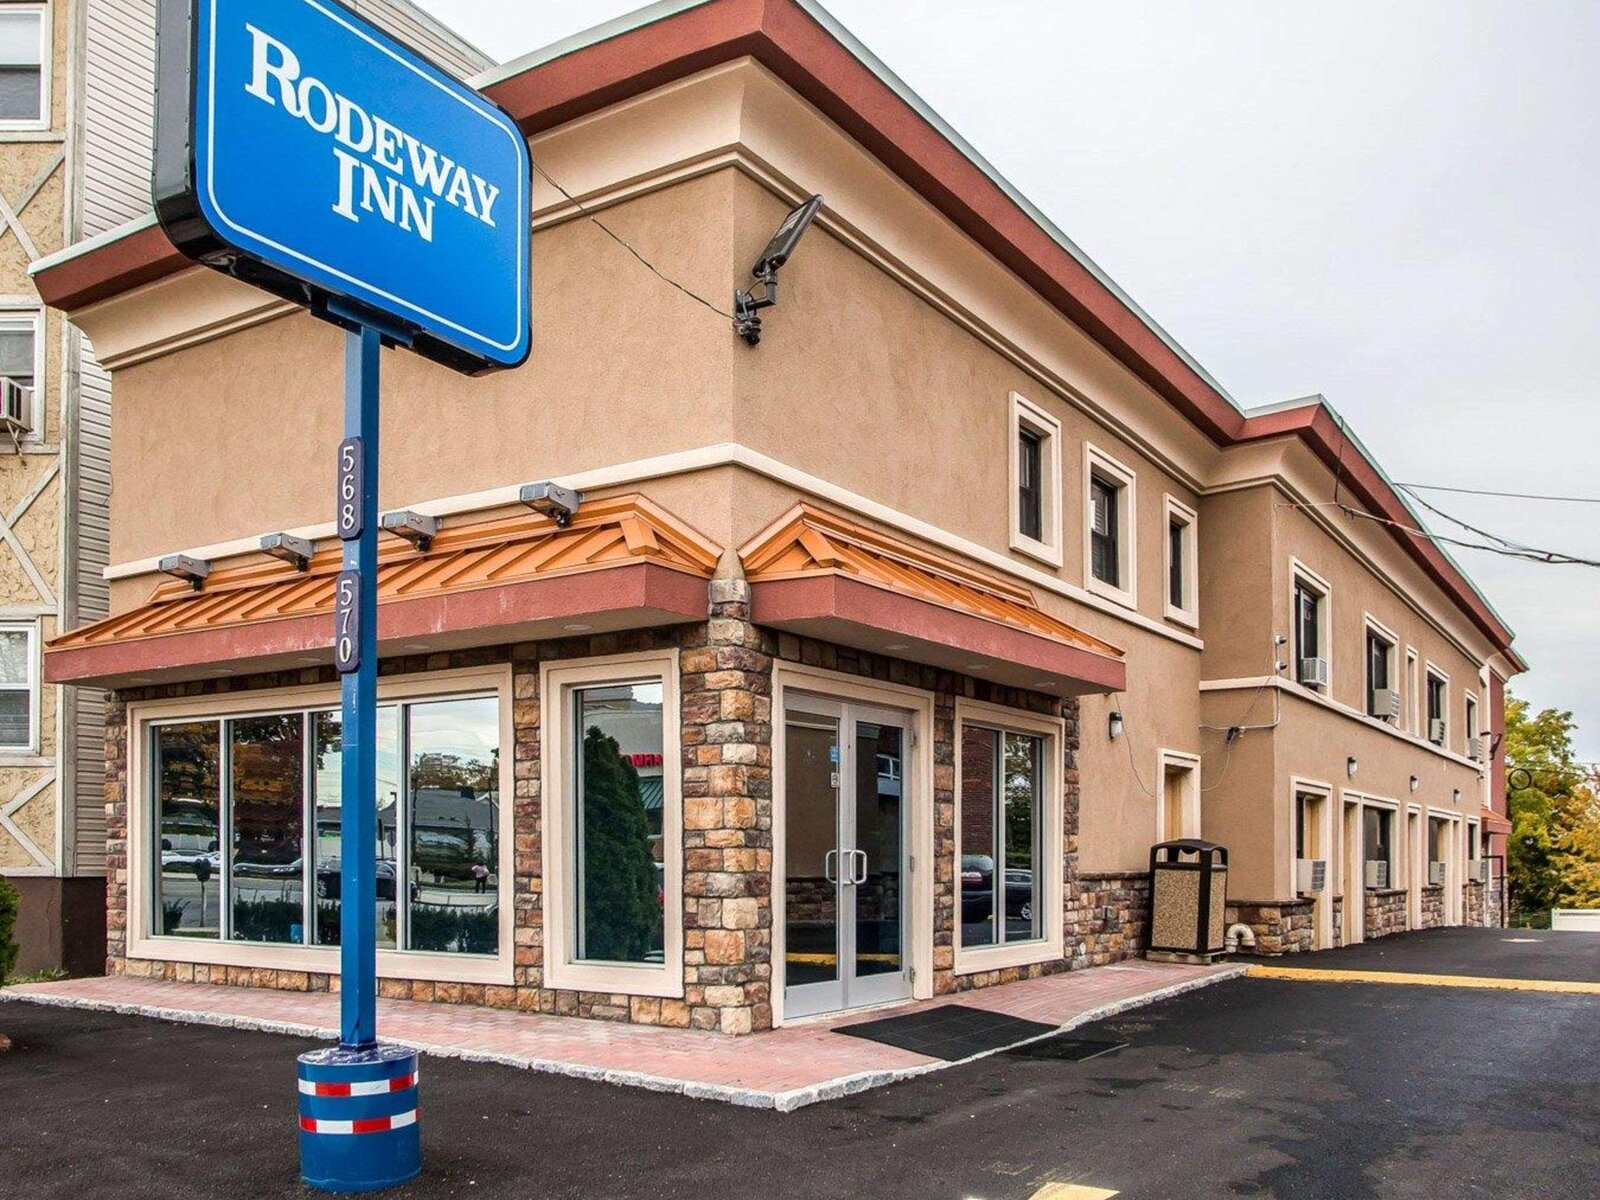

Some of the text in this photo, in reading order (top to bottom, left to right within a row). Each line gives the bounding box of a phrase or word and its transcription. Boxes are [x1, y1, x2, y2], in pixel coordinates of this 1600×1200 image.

[245, 23, 499, 227] RODEWAY
[332, 147, 435, 242] INN
[341, 445, 355, 530] 568
[339, 579, 353, 663] 570
